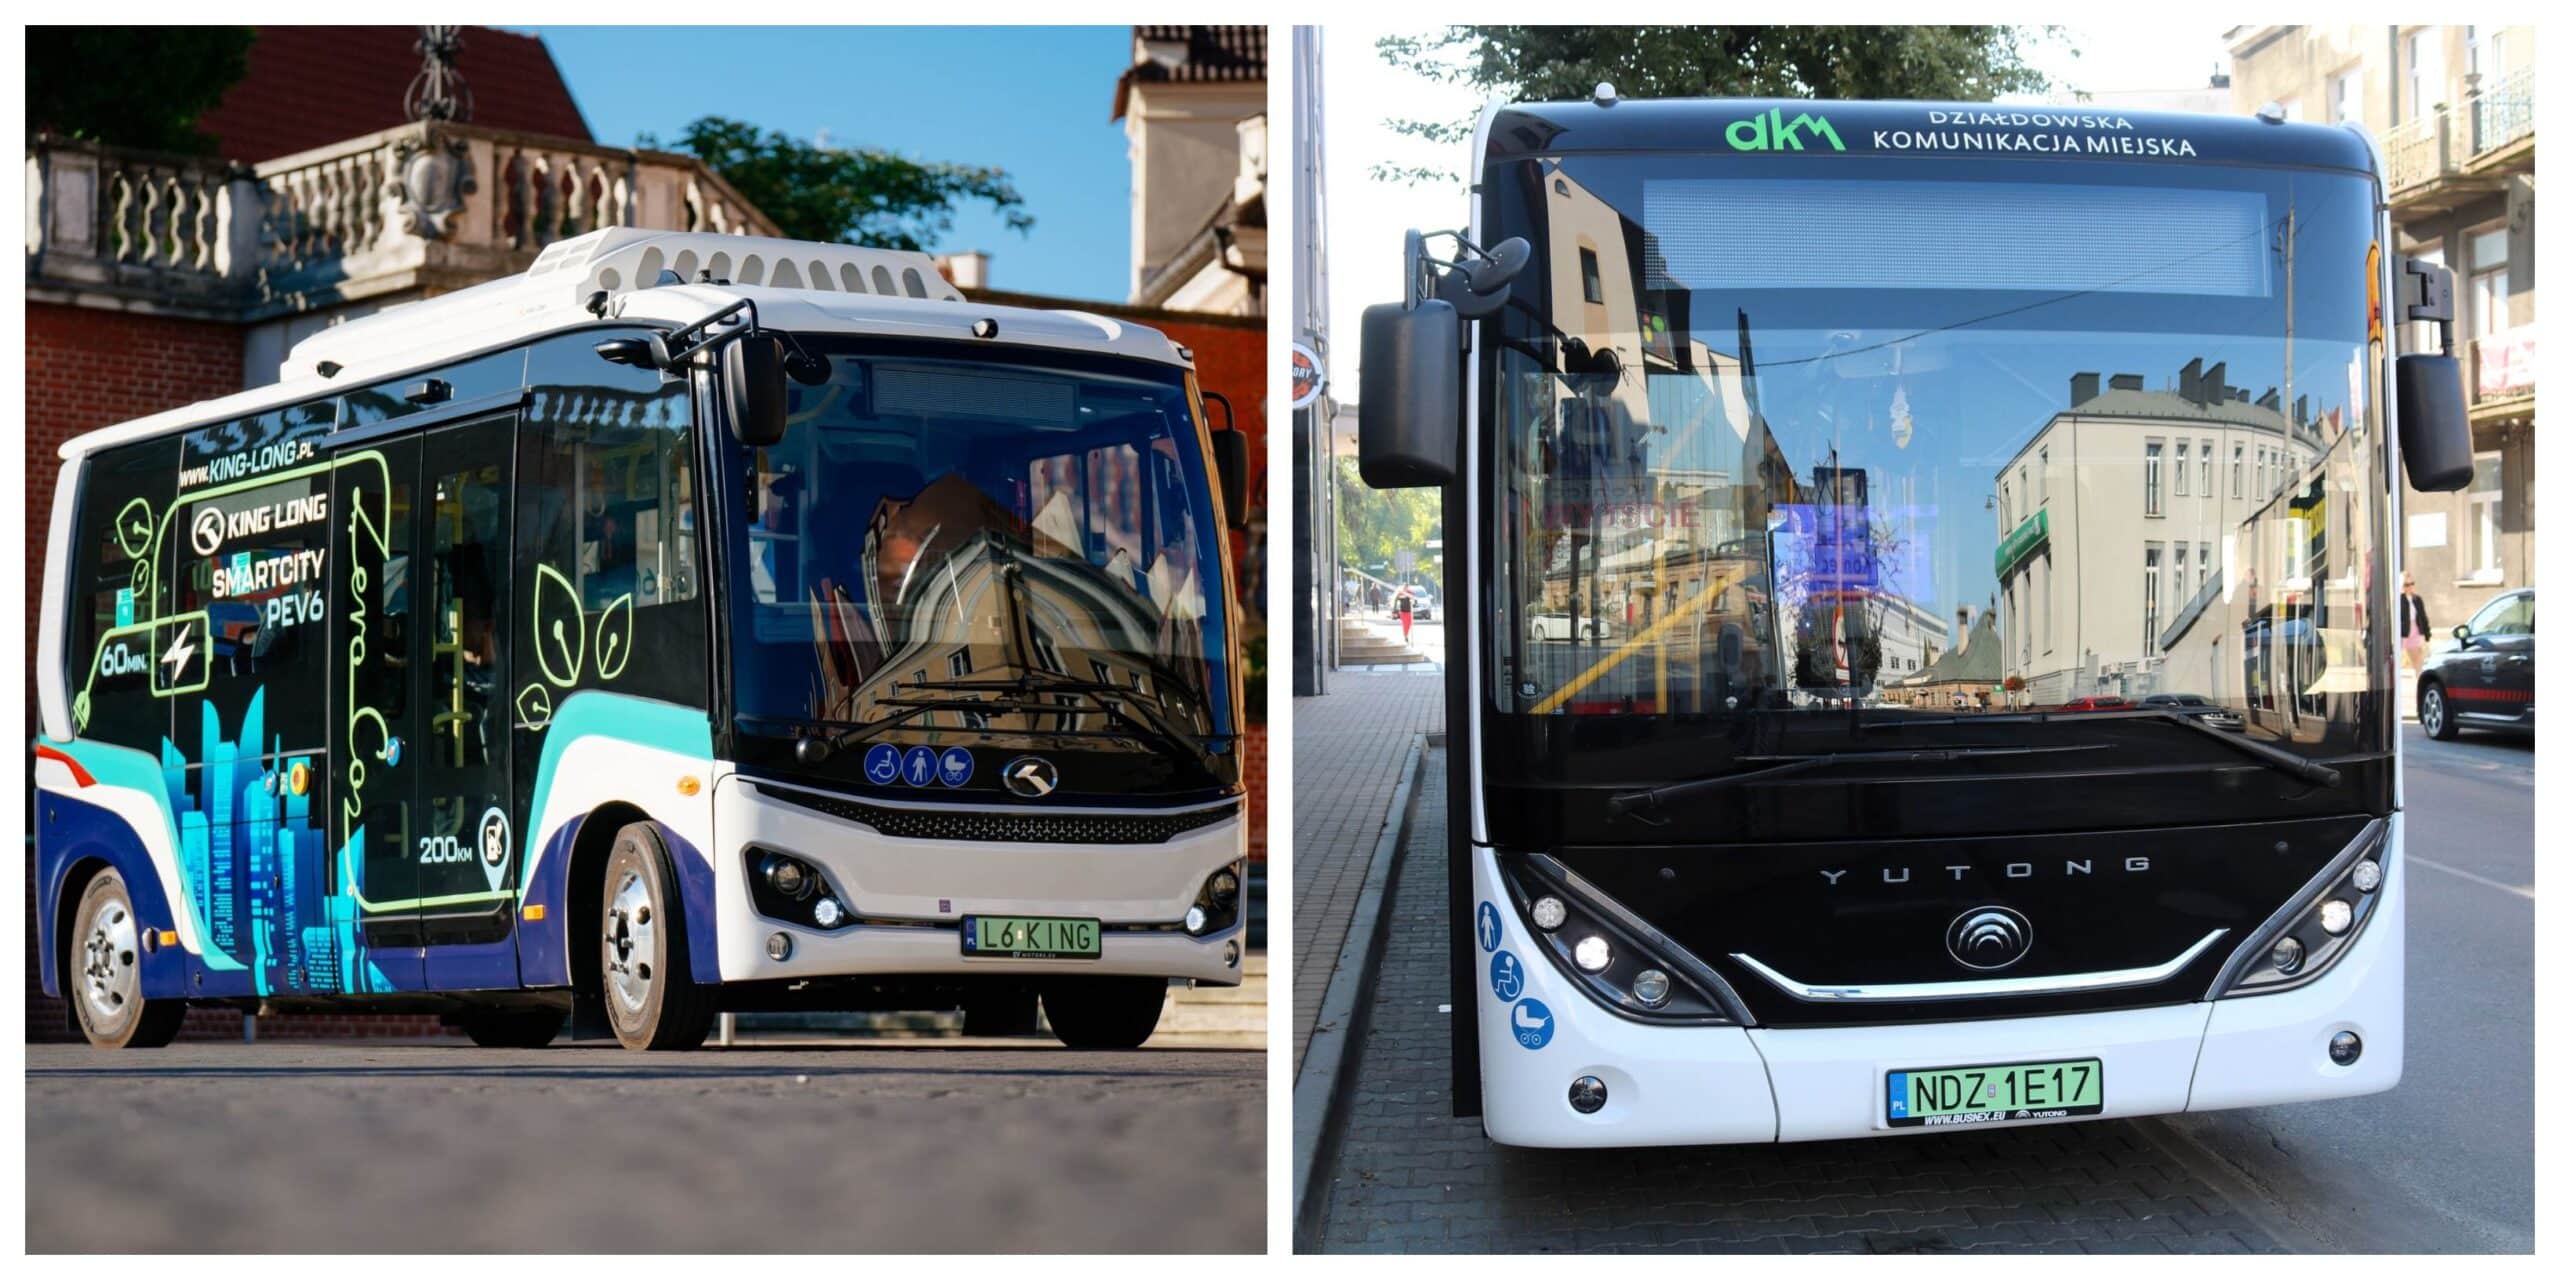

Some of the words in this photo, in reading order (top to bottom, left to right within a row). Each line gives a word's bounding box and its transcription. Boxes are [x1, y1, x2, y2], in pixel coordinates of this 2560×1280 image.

[1929, 111, 2134, 130] DZIAŁDOWSKA
[1873, 131, 2081, 153] KOMUNIKACJA
[2085, 135, 2197, 157] MIEJSKA
[227, 505, 270, 539] KING
[274, 493, 327, 529] LONG
[212, 548, 325, 598] SMARTCITY
[267, 590, 324, 630] PEV6
[1820, 857, 2150, 885] YUTONG
[1893, 1100, 1905, 1111] PL
[1915, 1073, 1986, 1112] NDZ
[2005, 1066, 2090, 1106] 1E17
